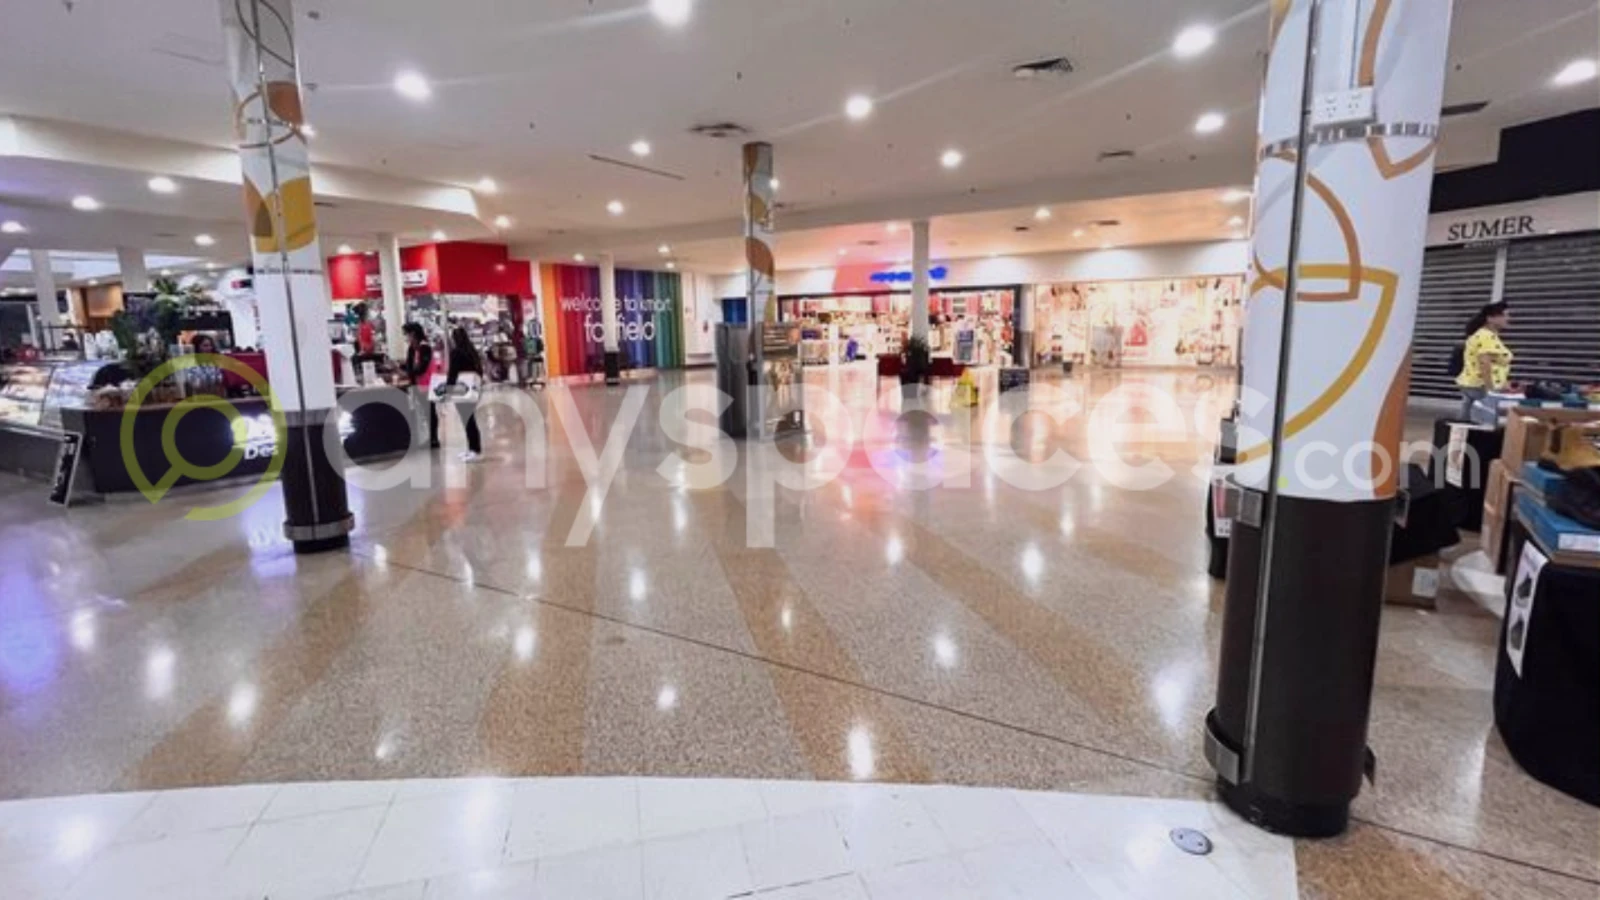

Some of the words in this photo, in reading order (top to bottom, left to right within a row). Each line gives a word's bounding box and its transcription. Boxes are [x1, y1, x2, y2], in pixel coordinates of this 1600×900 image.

[1447, 215, 1534, 241] SUMER
[560, 291, 622, 311] welcoe
[624, 294, 639, 311] to
[584, 313, 655, 342] fafield
